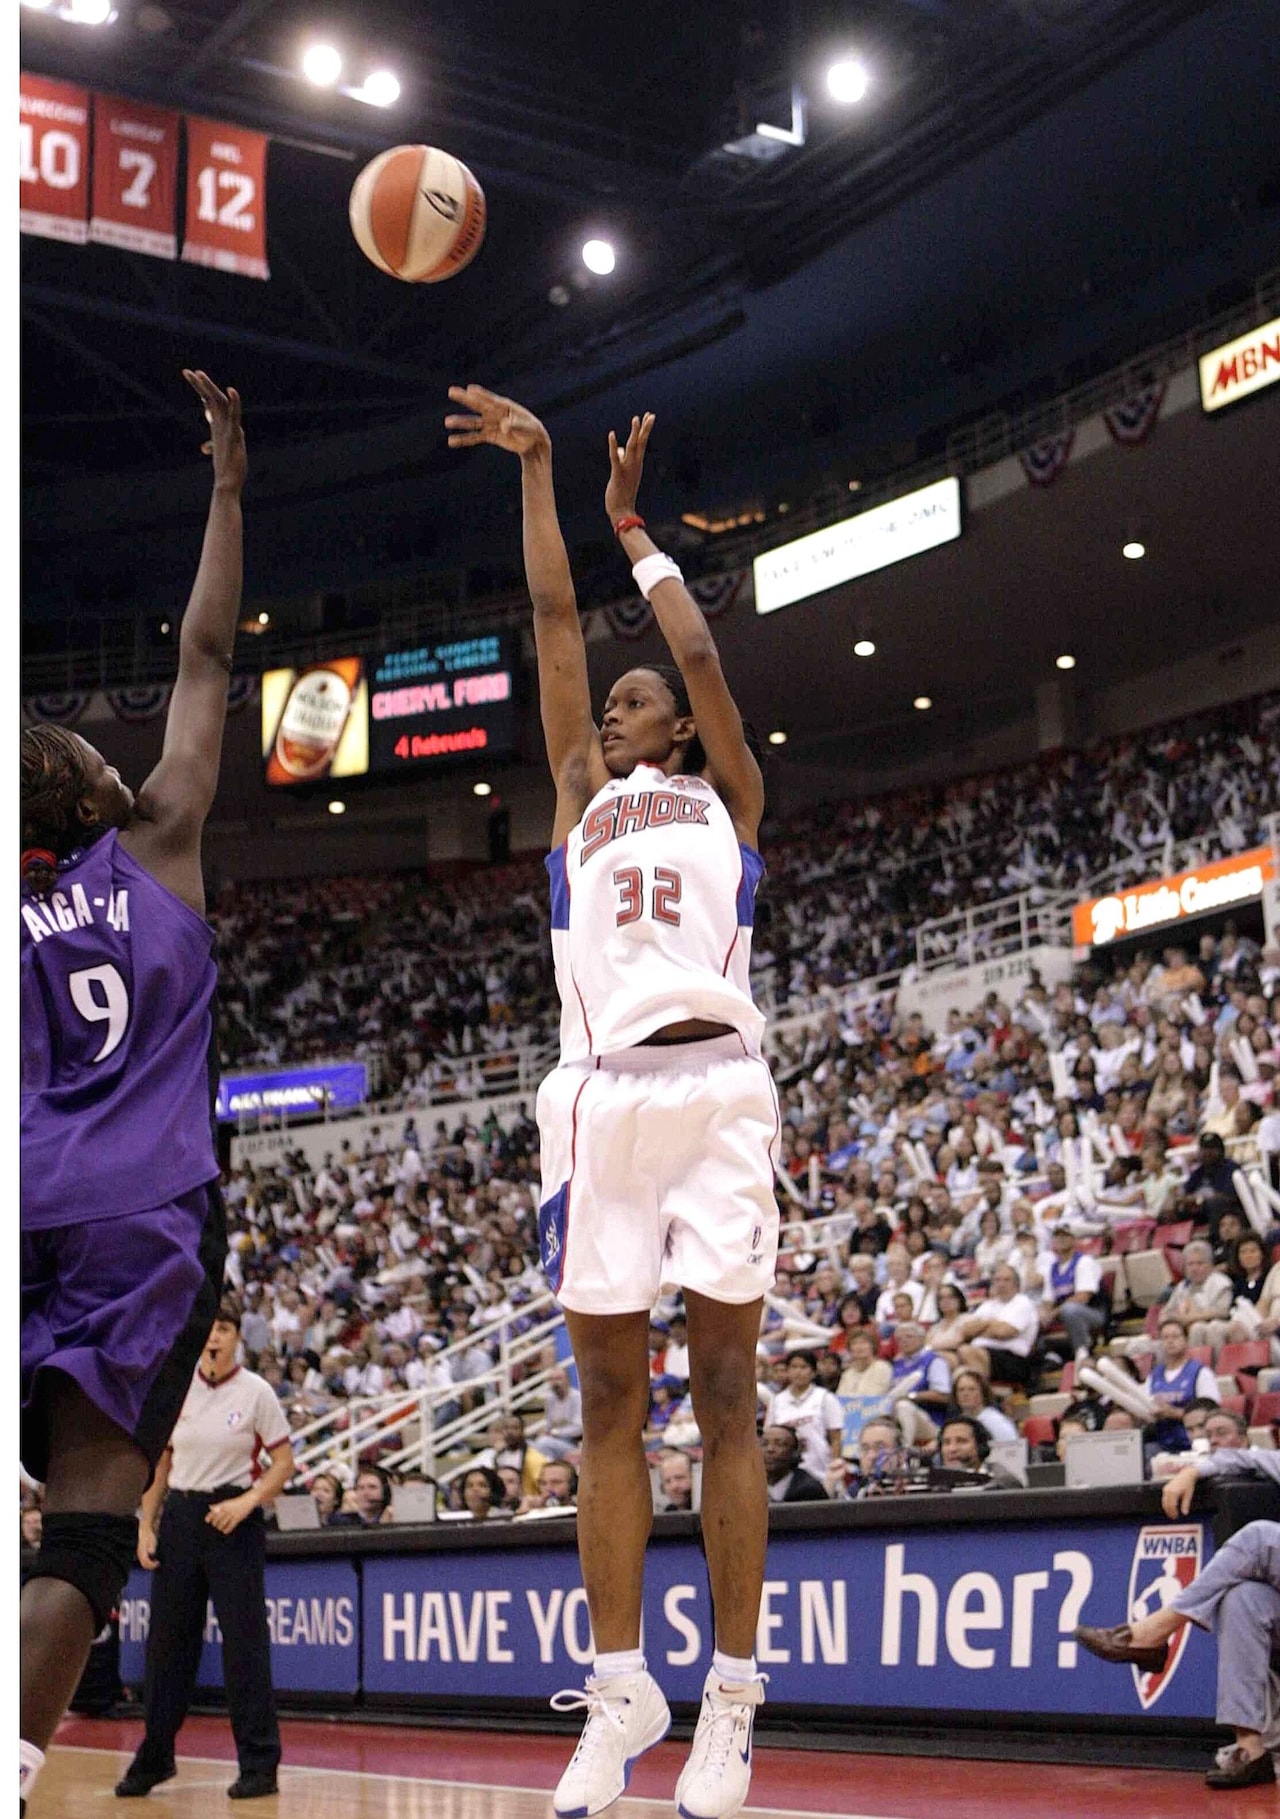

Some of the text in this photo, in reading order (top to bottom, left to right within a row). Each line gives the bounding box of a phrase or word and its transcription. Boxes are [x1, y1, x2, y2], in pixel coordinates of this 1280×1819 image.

[20, 122, 80, 190] 10
[118, 147, 157, 208] 7
[197, 166, 256, 233] 12
[393, 734, 410, 760] 4
[580, 790, 711, 867] SHOCK
[613, 865, 682, 927] 32
[69, 962, 129, 1063] 9
[1143, 1536, 1198, 1555] WNBA
[118, 1598, 152, 1643] PIR
[264, 1596, 354, 1647] REAMS
[382, 1543, 1094, 1670] HAVE YO SEN her?
